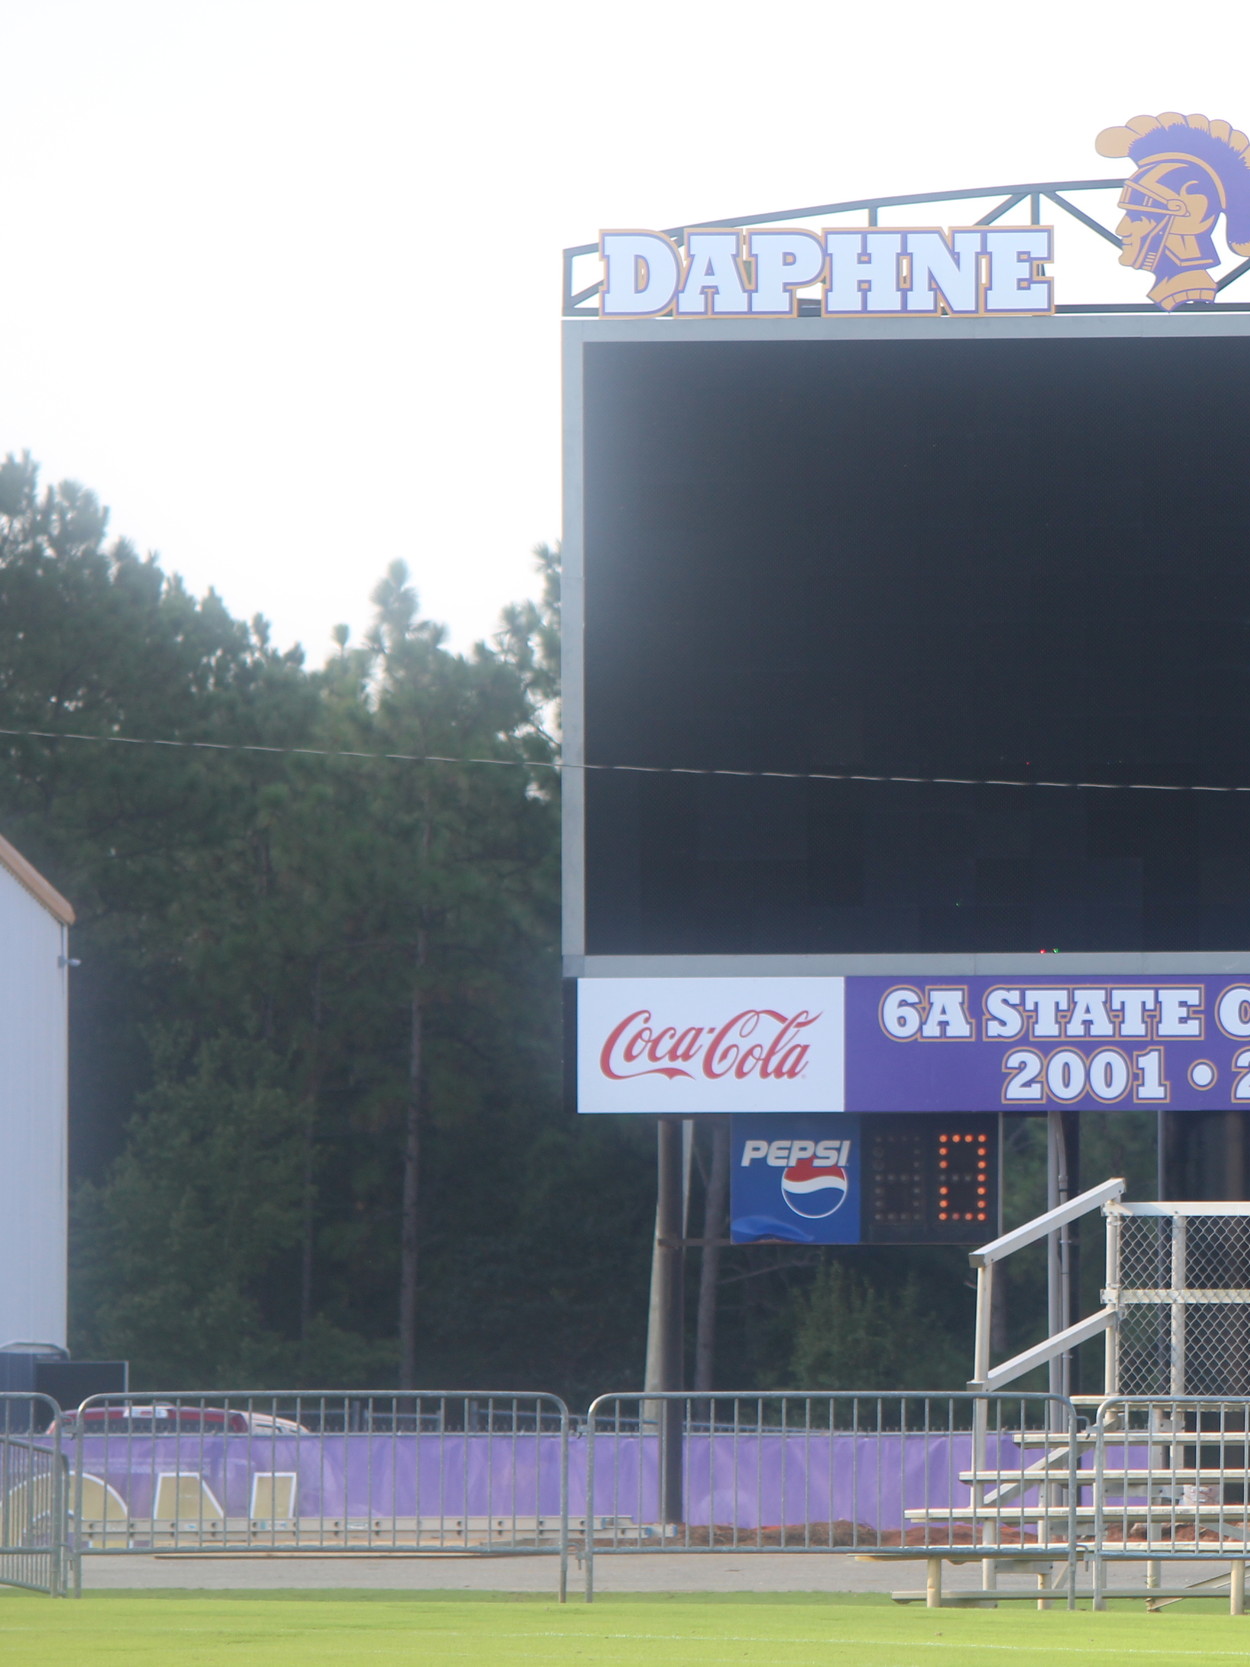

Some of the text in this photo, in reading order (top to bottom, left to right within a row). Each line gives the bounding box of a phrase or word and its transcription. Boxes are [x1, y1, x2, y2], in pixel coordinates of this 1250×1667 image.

[599, 226, 1054, 318] DAPHNE
[879, 984, 976, 1041] 6A
[983, 984, 1204, 1041] STATE
[600, 1009, 824, 1081] Coca-Cola
[1002, 1047, 1170, 1103] 2001
[740, 1140, 851, 1167] PEPSI
